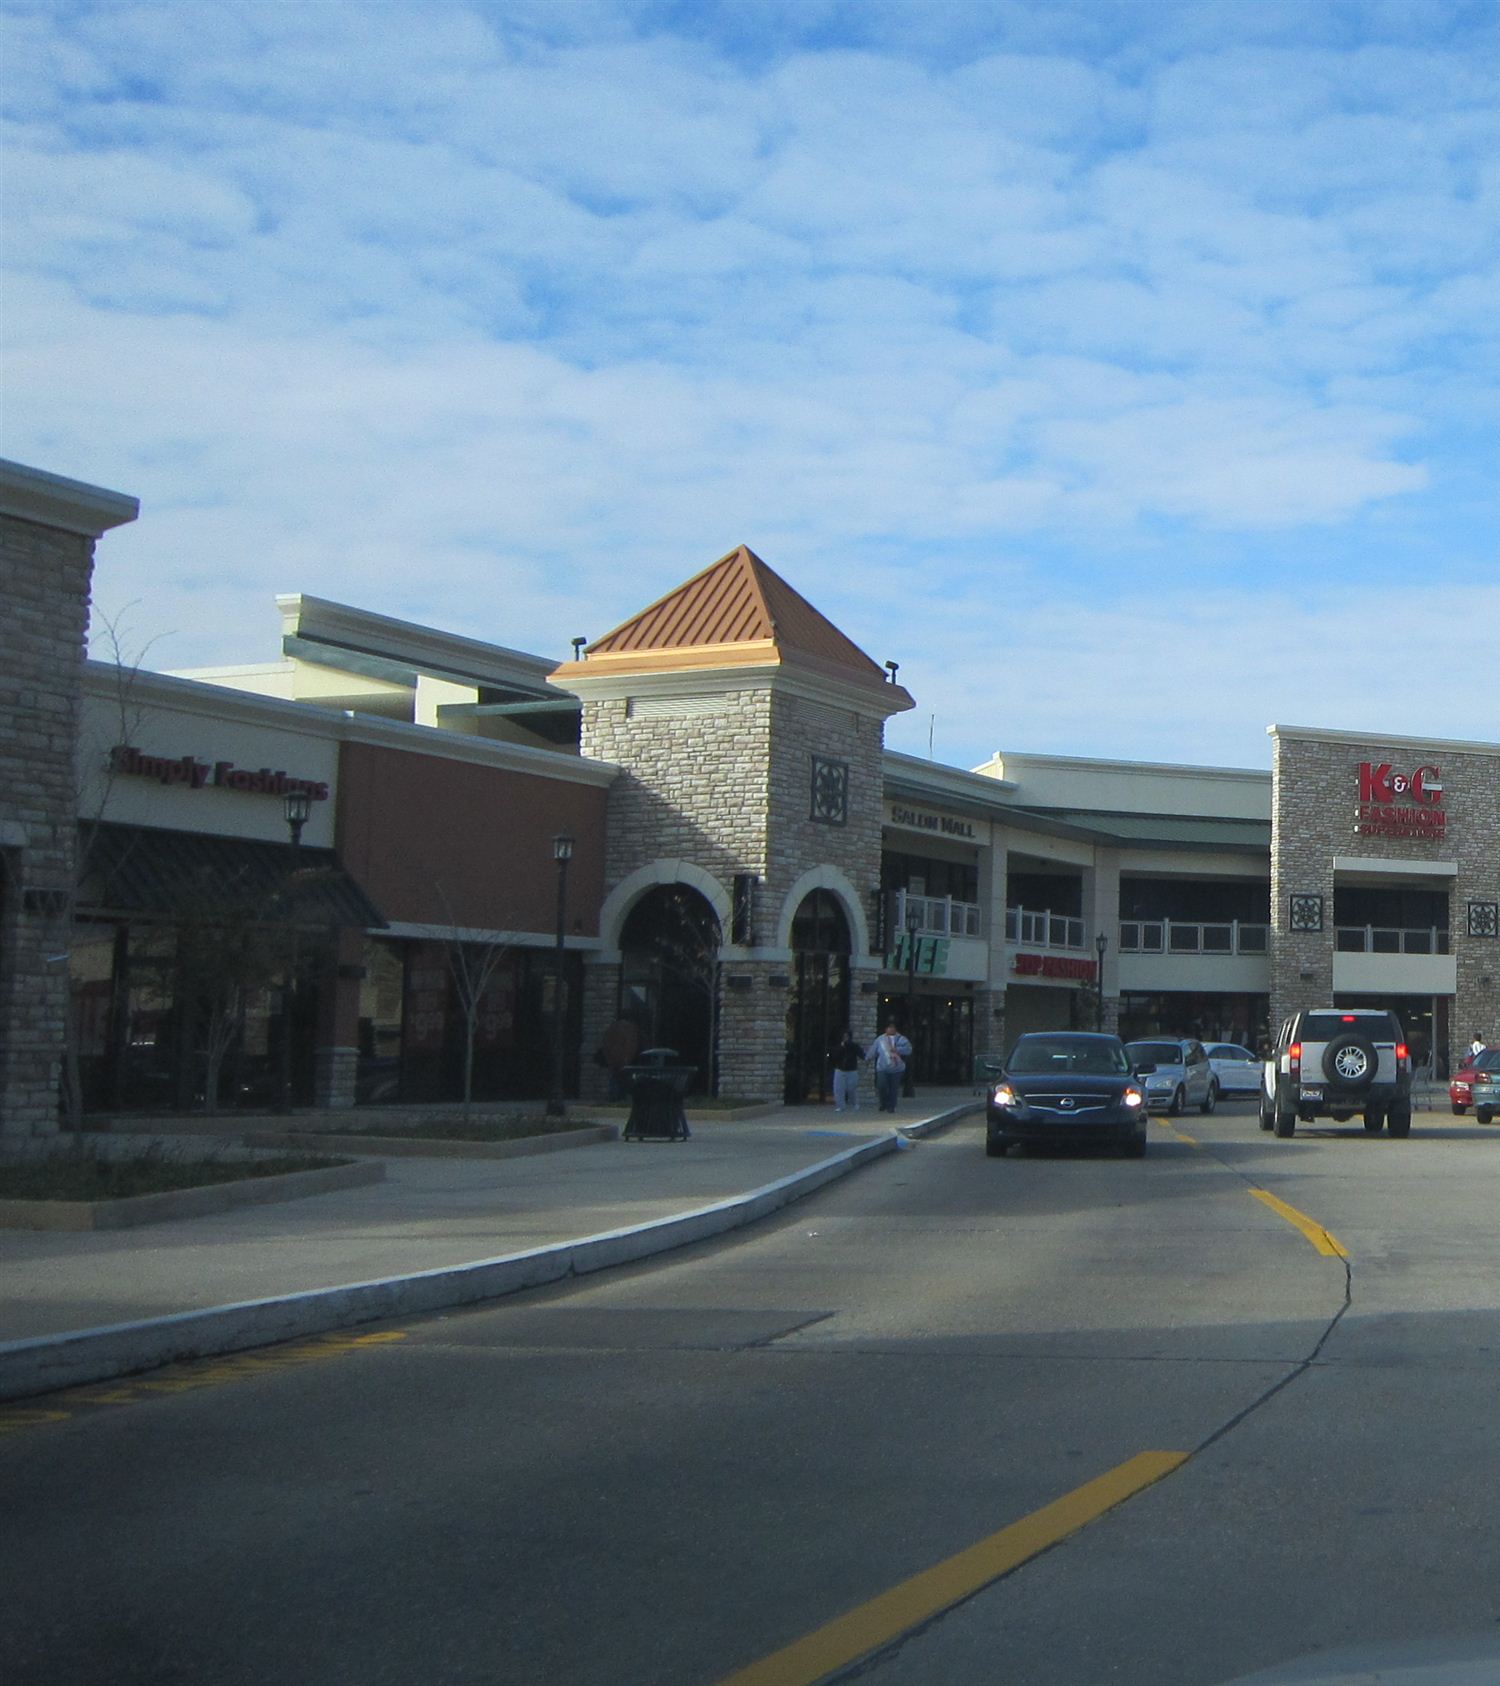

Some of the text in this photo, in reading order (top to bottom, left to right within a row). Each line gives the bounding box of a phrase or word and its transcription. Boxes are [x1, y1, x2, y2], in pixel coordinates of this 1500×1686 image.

[110, 745, 330, 801] Simply Fashions
[1358, 761, 1443, 805] K&G
[941, 816, 976, 838] MALL
[1359, 806, 1447, 826] FASHION
